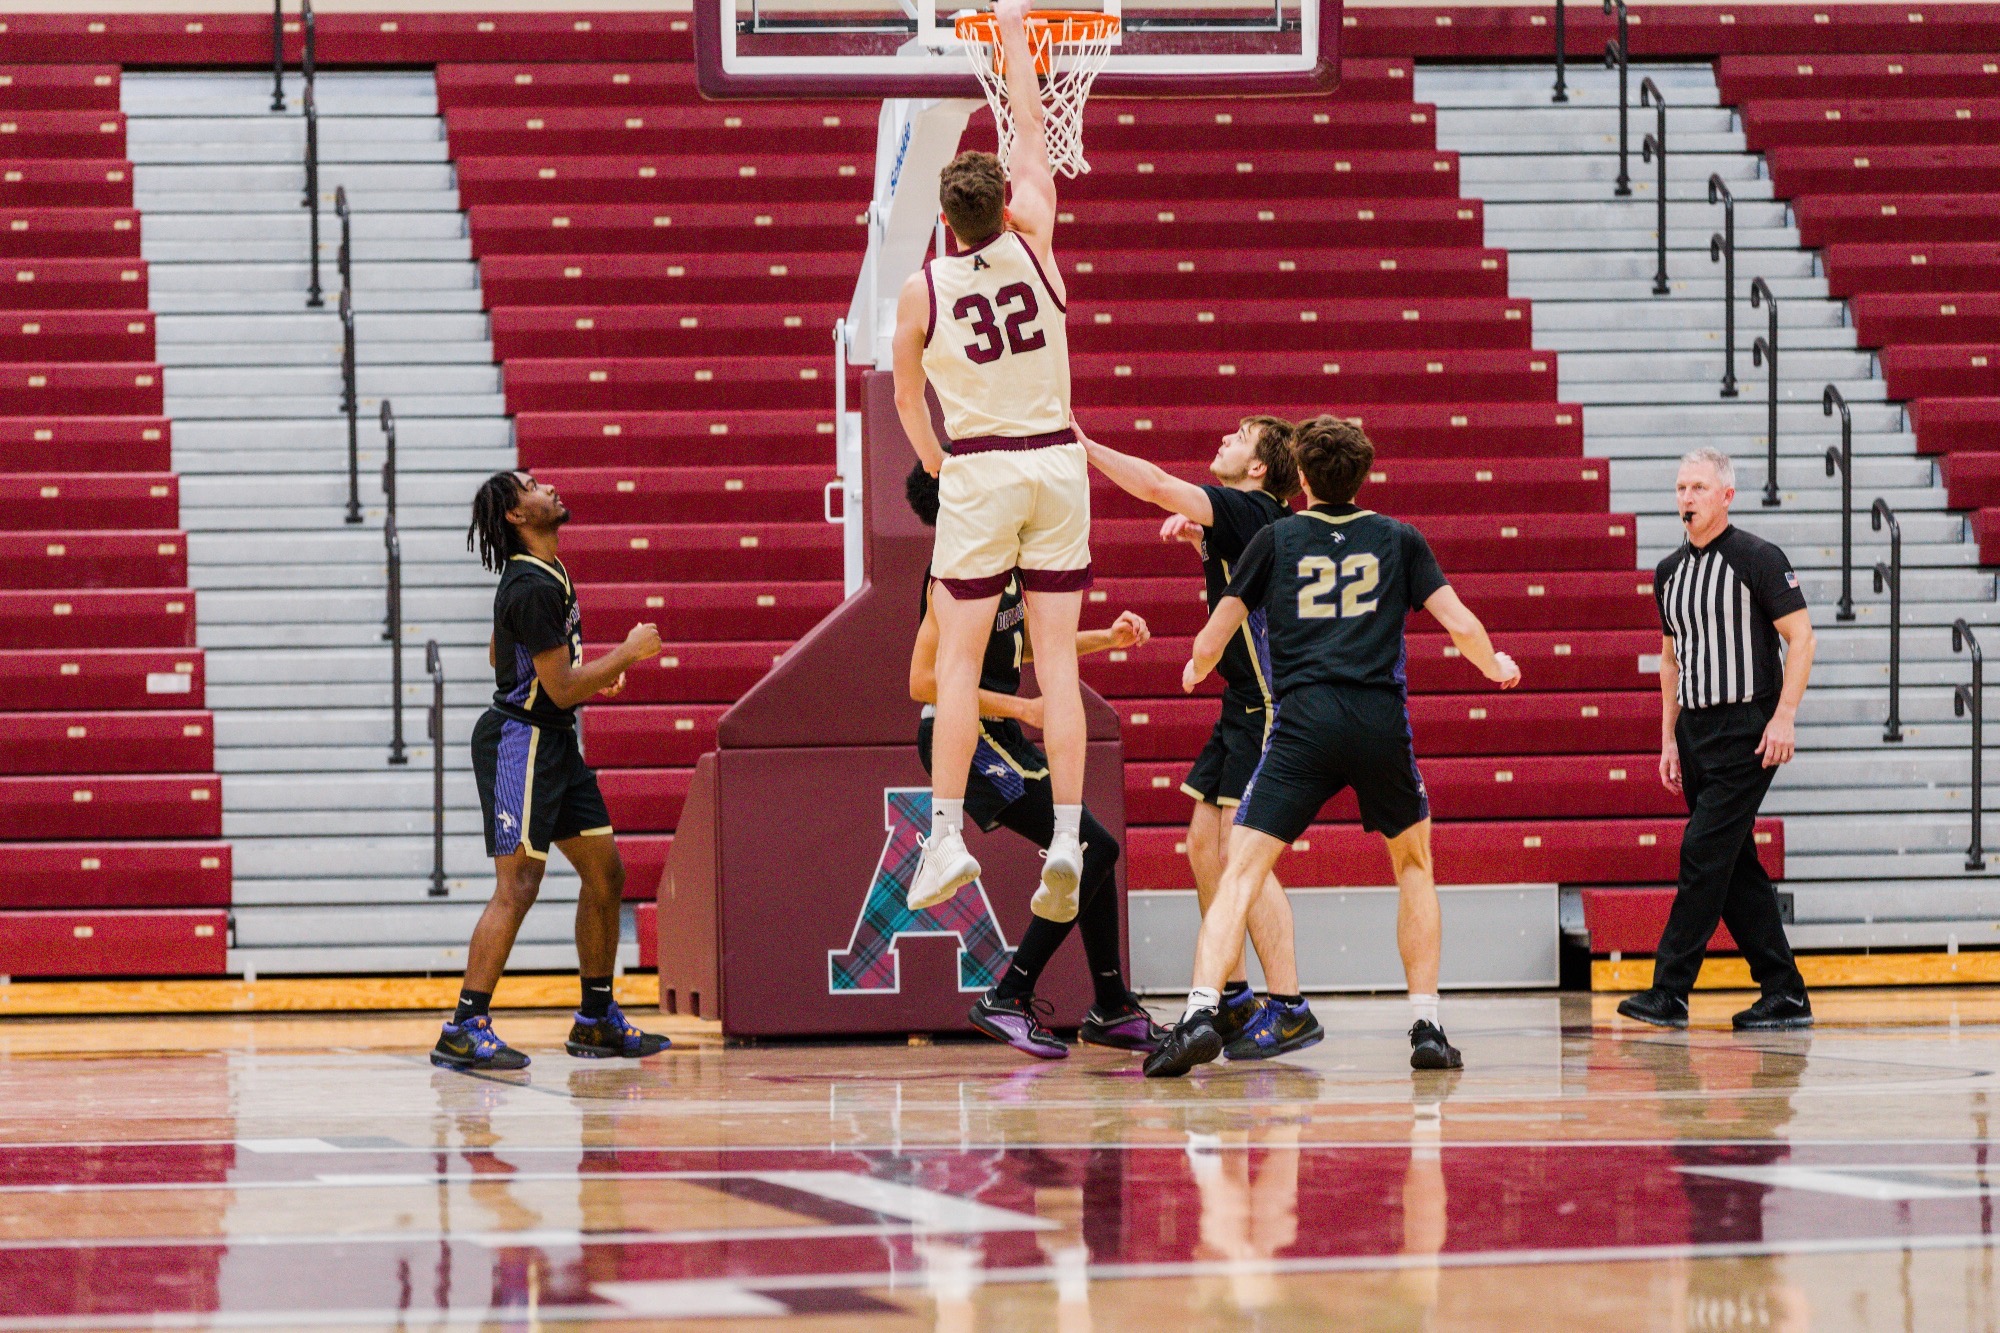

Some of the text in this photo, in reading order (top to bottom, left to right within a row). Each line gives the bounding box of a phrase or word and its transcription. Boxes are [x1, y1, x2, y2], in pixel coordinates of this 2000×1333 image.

[973, 254, 991, 272] A
[952, 281, 1047, 365] 32
[1297, 552, 1380, 619] 22
[828, 787, 1018, 994] A
